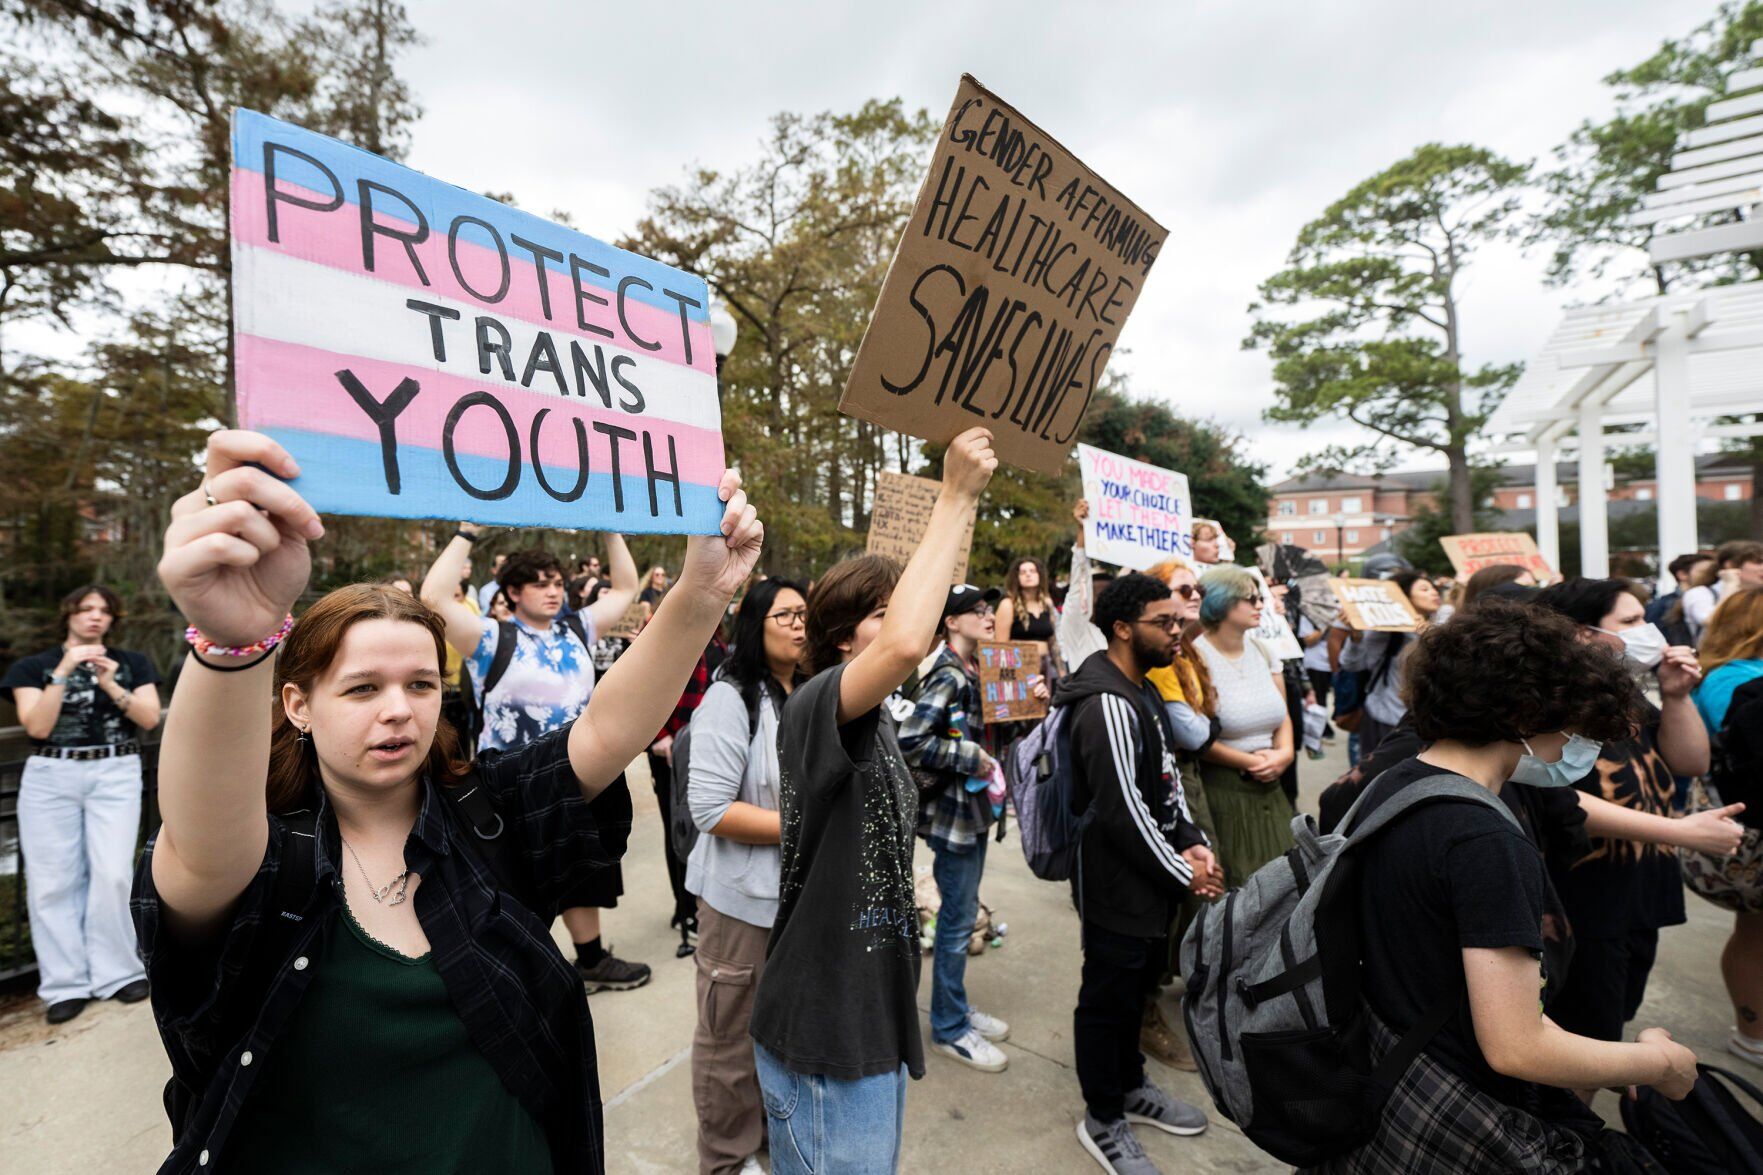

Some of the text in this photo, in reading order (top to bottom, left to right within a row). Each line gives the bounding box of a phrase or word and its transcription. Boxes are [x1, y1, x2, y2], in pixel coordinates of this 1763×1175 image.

[949, 98, 1159, 276] GENDER AFFIRMING
[262, 141, 702, 365] PROTECT
[923, 155, 1134, 326] HEALTHCARE
[406, 299, 646, 413] TRANS
[880, 264, 1112, 444] SAVES LIVES
[334, 368, 684, 517] YOUTH
[1086, 450, 1173, 494] YOU MADE
[1098, 497, 1180, 531] LET THEM
[1101, 479, 1182, 516] YOUR CHOICE
[1096, 521, 1193, 557] MAKE THIERS
[1340, 585, 1393, 603] HATE
[1356, 602, 1416, 628] KILLS
[981, 646, 1023, 668] TRANS
[986, 681, 1028, 703] HUMAN
